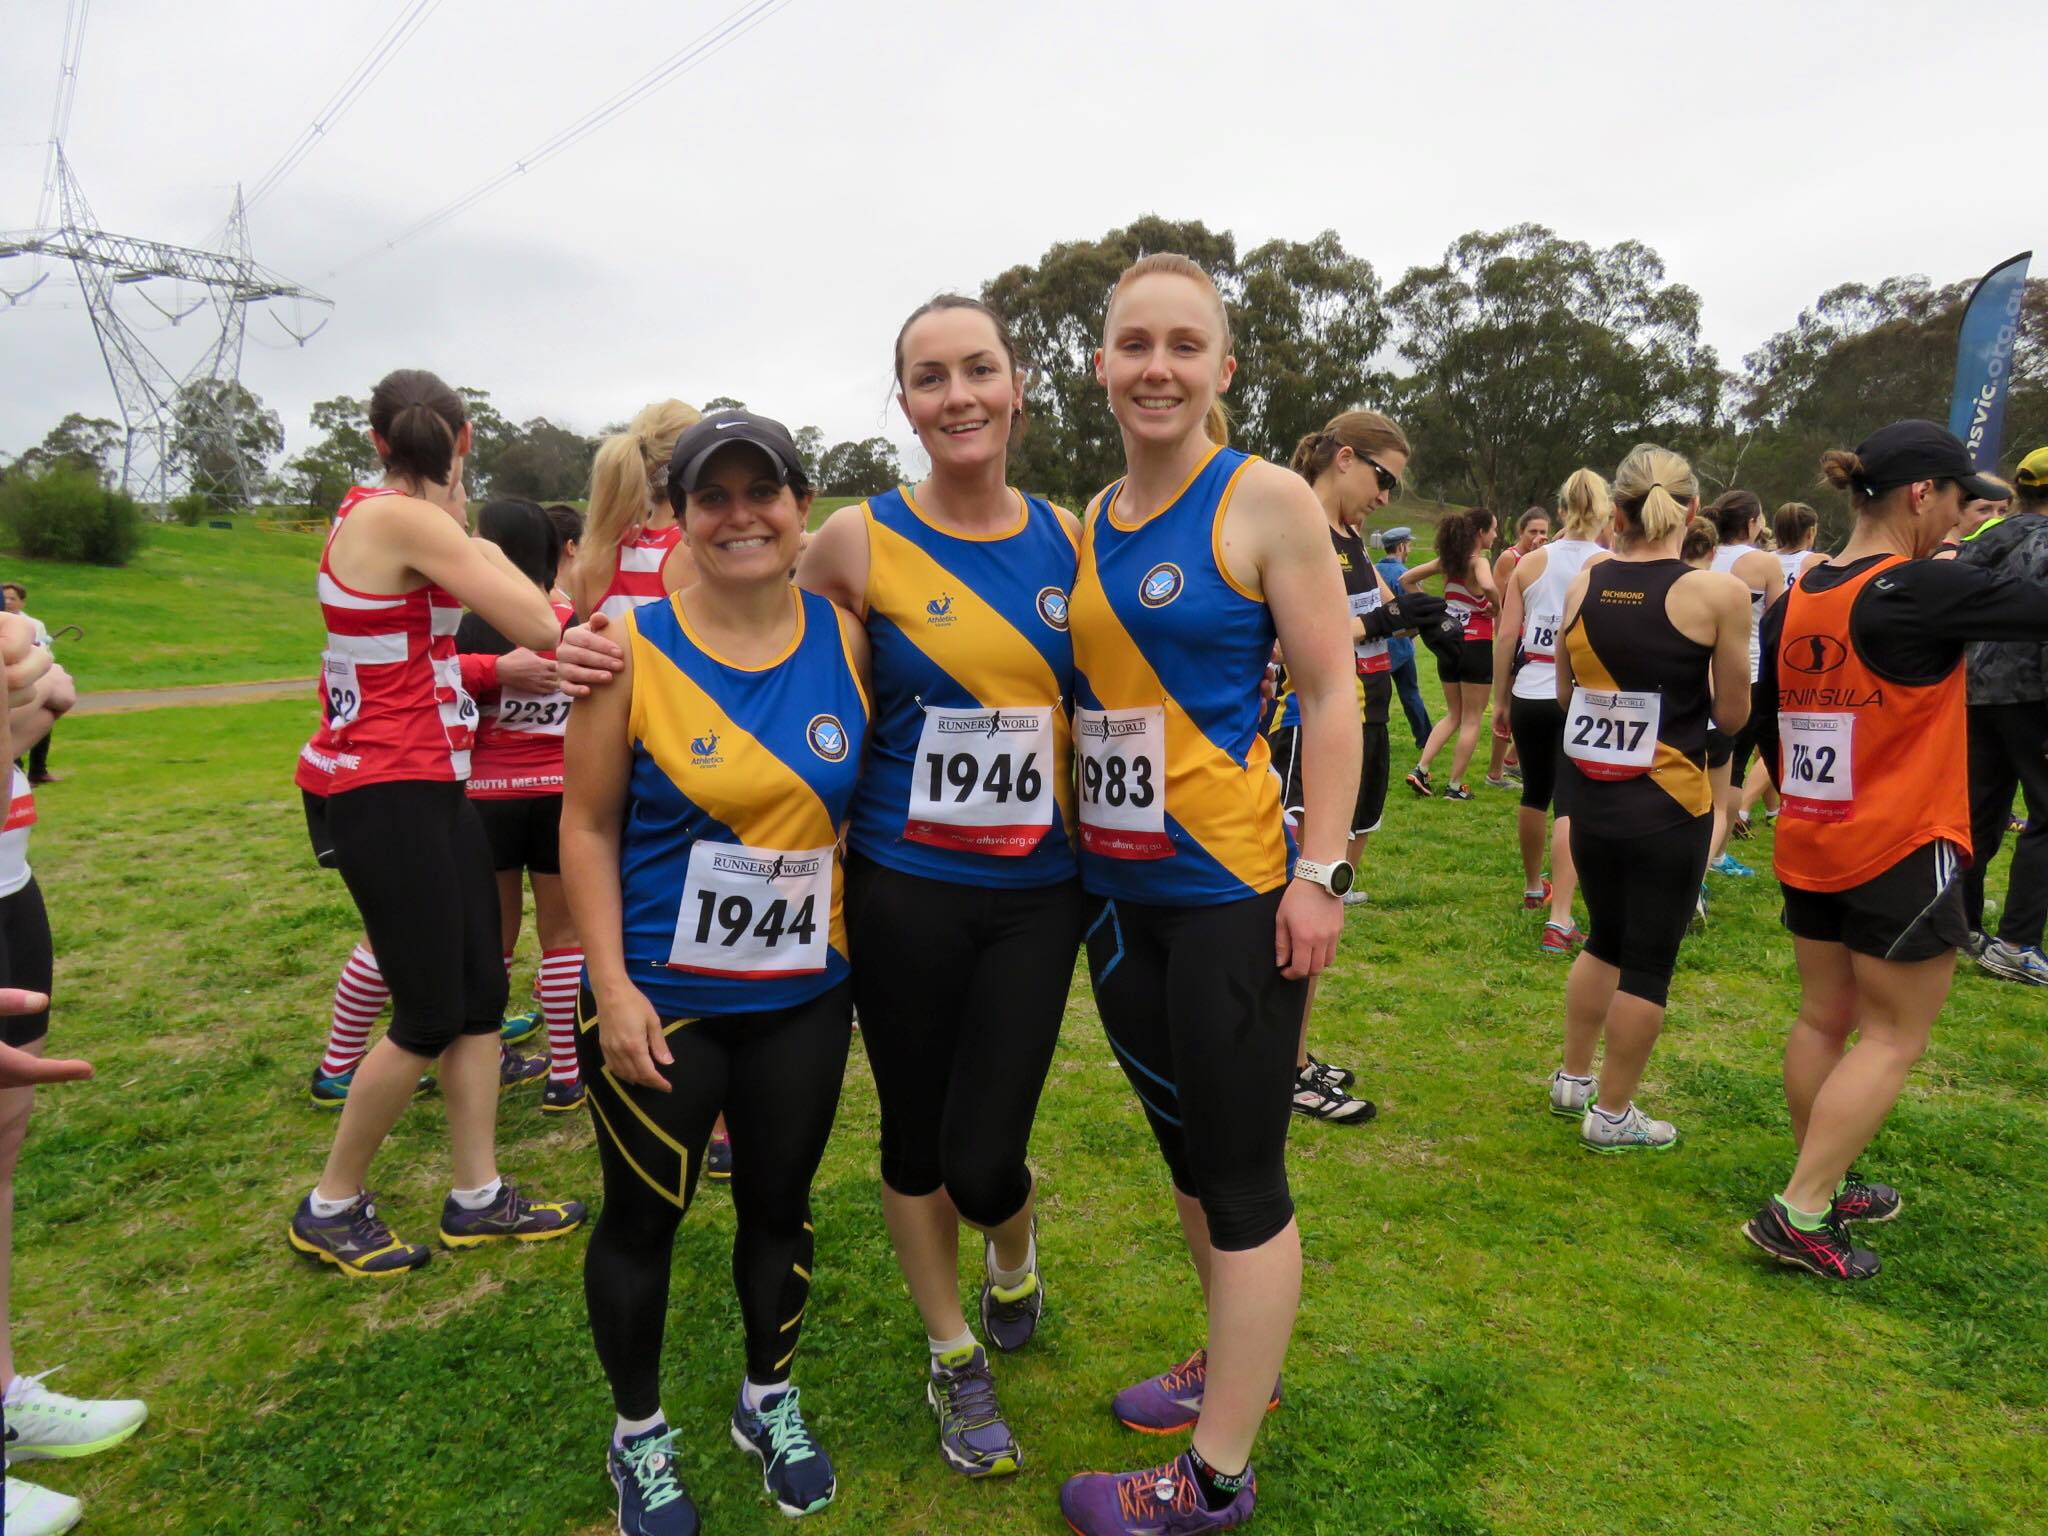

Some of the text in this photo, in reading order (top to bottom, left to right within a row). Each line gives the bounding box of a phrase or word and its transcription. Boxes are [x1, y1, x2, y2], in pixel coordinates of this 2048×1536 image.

[1601, 590, 1645, 600] RICHMOND
[926, 615, 958, 625] Athletics
[1533, 626, 1558, 647] 18
[500, 700, 572, 725] 2237
[938, 719, 1039, 731] RUNNERS WORLD
[1109, 721, 1147, 734] WORLD
[1571, 715, 1650, 752] 2217
[690, 756, 724, 766] Athletics
[465, 778, 508, 790] SOUTH
[926, 752, 1042, 804] 1946
[713, 856, 819, 875] RUNNERS WORLD
[694, 889, 817, 948] 1944
